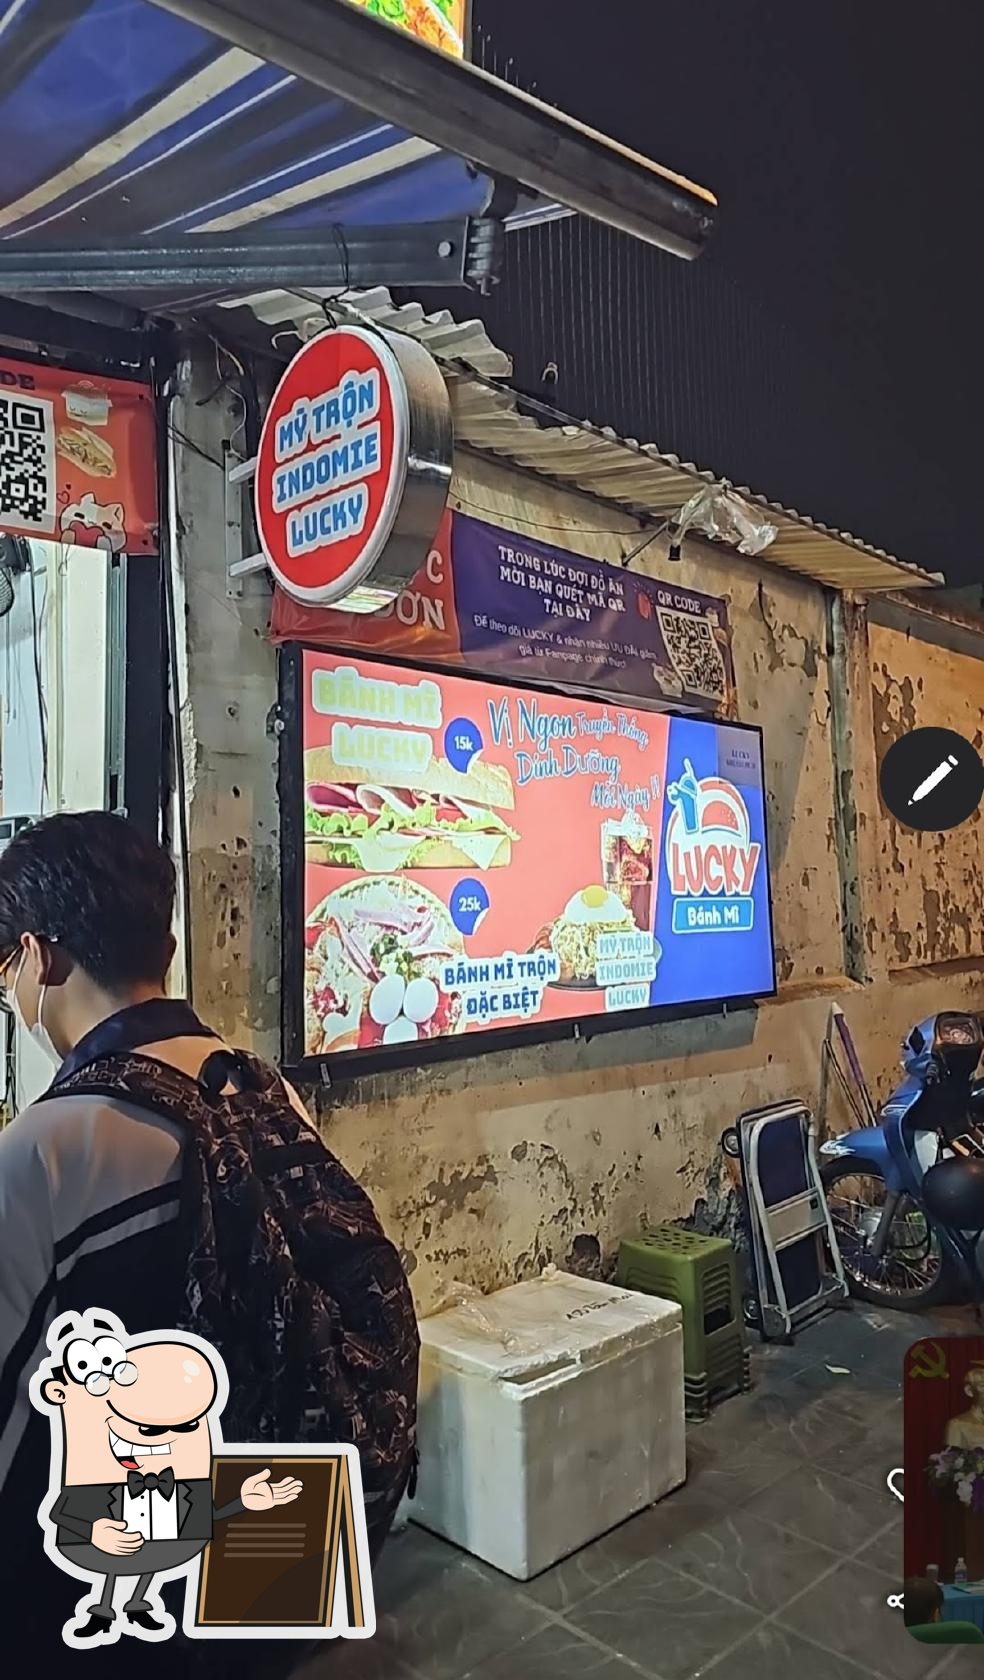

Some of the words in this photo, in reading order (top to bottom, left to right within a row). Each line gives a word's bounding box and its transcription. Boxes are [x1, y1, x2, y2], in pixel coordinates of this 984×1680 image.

[312, 379, 373, 433] TRỘN
[277, 433, 377, 502] INDOMIE
[291, 494, 363, 547] LUCKY
[498, 545, 541, 572] TRONG
[543, 559, 566, 578] LÚC
[568, 567, 589, 589] ĐỢI
[591, 569, 606, 591] ĐỒ
[499, 565, 526, 587] MỜI
[528, 574, 553, 596] BẠN
[555, 583, 585, 604] QUÉT
[608, 597, 626, 612] QR
[657, 590, 673, 607] QR
[674, 594, 702, 613] CODE
[543, 598, 563, 619] TẠI
[565, 603, 591, 622] ĐÂY
[474, 615, 489, 627] Để
[489, 618, 507, 633] theo
[522, 627, 554, 643] LUCKY
[556, 634, 563, 645] &
[545, 647, 584, 663] Fanpage
[319, 674, 396, 714] BÁNH
[488, 697, 512, 747] Vị
[518, 698, 575, 751] Ngon
[338, 733, 426, 764] LUCKY
[454, 735, 474, 752] 15k
[515, 750, 560, 785] Dinh
[562, 745, 620, 784] Dưỡng
[672, 842, 759, 894] LUCKY
[459, 897, 481, 912] 25k
[687, 904, 722, 926] Bánh
[619, 933, 651, 954] TRỘN
[444, 962, 489, 986] BÁNH
[518, 955, 556, 981] TRỘN
[599, 962, 654, 981] INDOMIE
[466, 990, 498, 1018] ĐẶC
[502, 986, 539, 1013] BIỆT
[608, 987, 647, 1006] LUCKY
